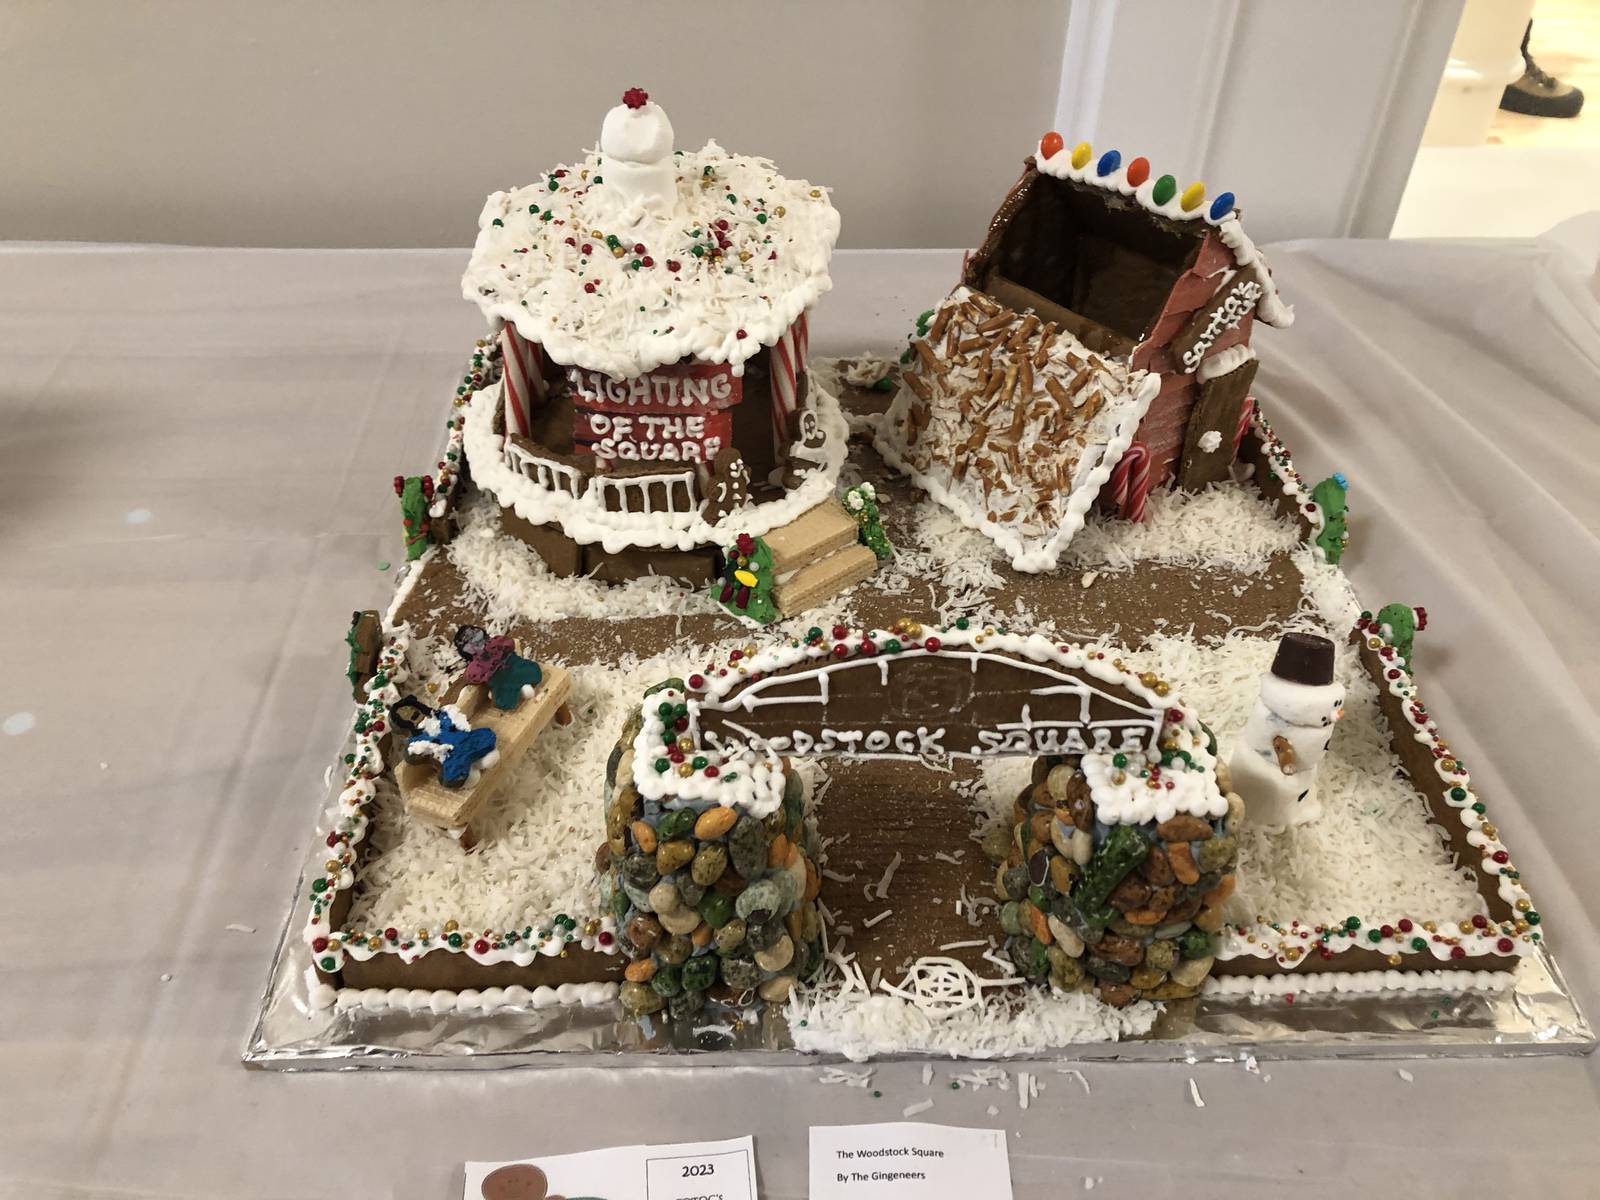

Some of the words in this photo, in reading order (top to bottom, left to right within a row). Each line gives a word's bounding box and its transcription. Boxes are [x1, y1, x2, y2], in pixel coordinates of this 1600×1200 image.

[569, 368, 732, 406] LIGHTING
[590, 413, 633, 442] OF
[638, 415, 706, 440] THE
[970, 727, 1147, 754] SQUARE
[836, 1150, 854, 1159] The
[856, 1147, 910, 1158] Woodstock
[911, 1147, 945, 1159] Square
[681, 1163, 715, 1178] 2023
[836, 1173, 849, 1184] By
[851, 1172, 869, 1182] The
[871, 1170, 926, 1182] Gingeneers
